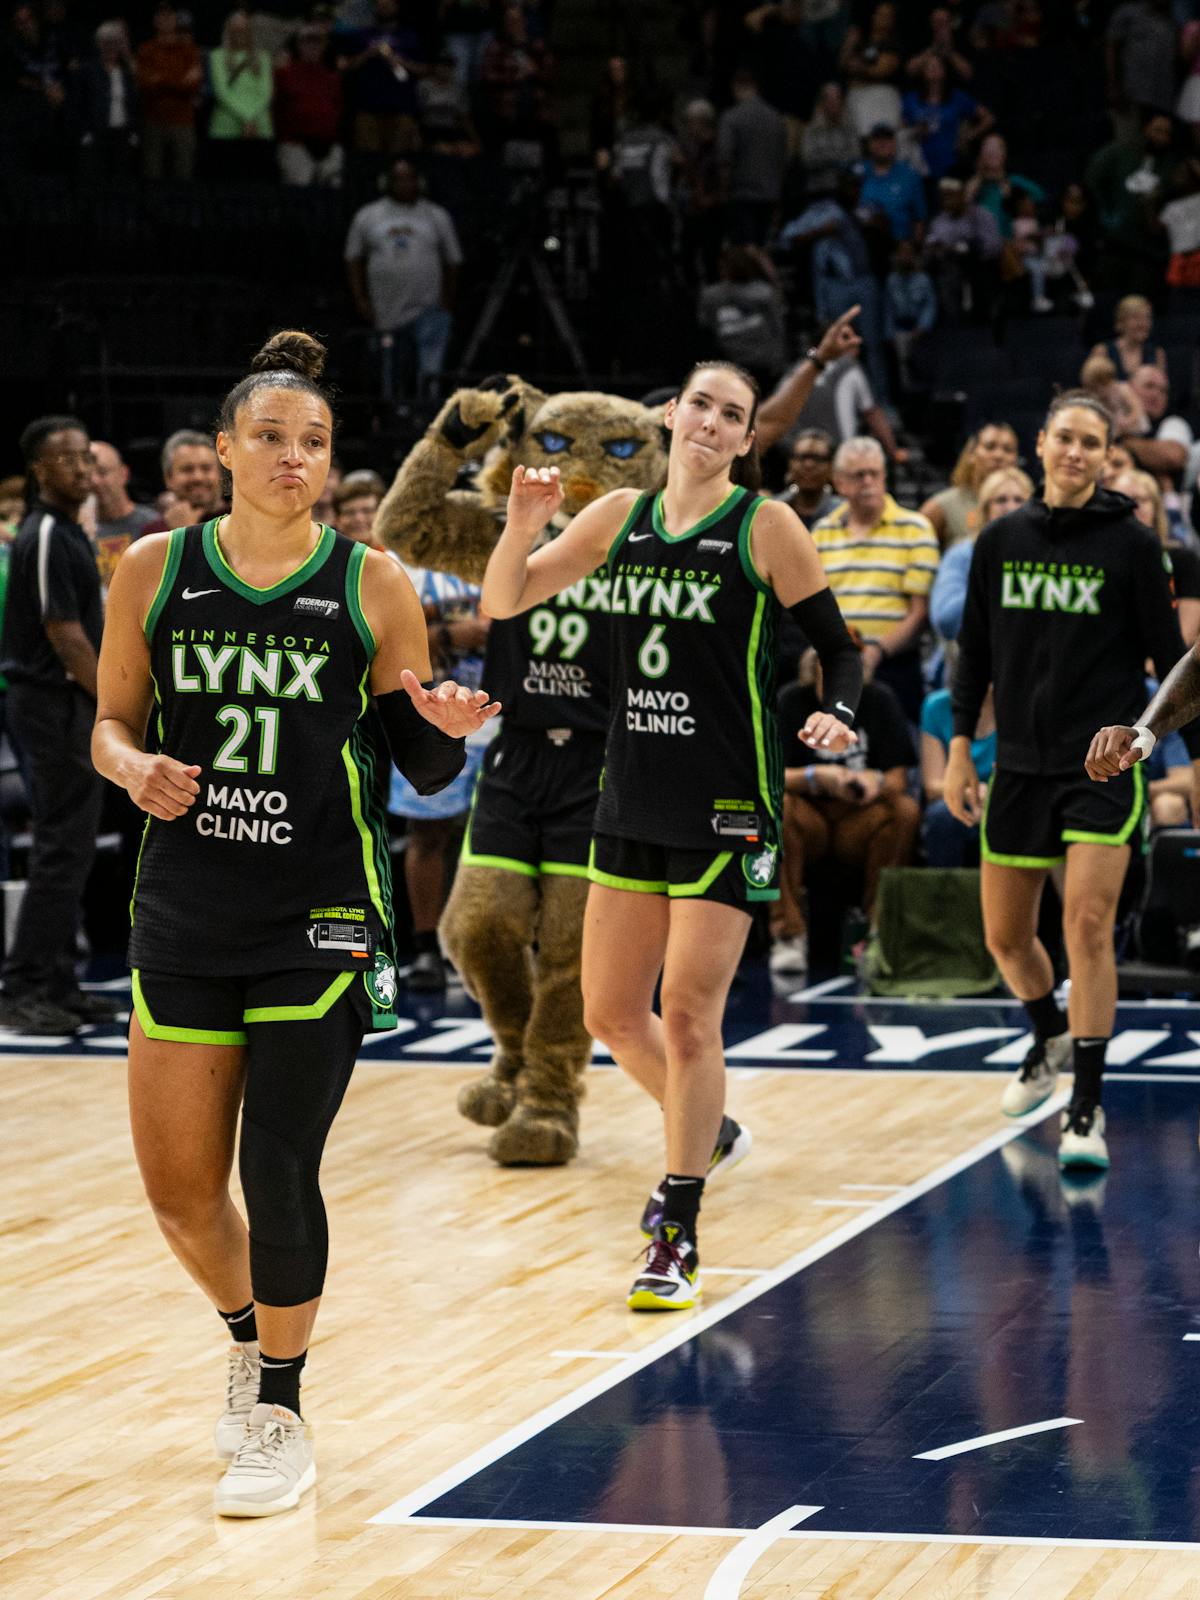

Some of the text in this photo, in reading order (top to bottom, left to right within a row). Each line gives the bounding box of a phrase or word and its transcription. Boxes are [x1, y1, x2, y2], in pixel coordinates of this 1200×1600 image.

[1002, 561, 1105, 578] MINNESOTA
[295, 597, 339, 609] FEDERATED
[611, 575, 721, 623] LYNX
[1001, 571, 1105, 615] LYNX
[172, 629, 330, 653] MINNESOTA
[528, 608, 590, 660] 99
[638, 623, 670, 679] 6
[172, 644, 329, 702] LYNX
[528, 660, 587, 681] MAYO
[522, 676, 592, 698] CLINIC
[627, 688, 690, 712] MAYO
[212, 704, 280, 775] 21
[626, 711, 696, 736] CLINIC
[206, 783, 288, 815] MAYO
[196, 812, 293, 845] CLINIC
